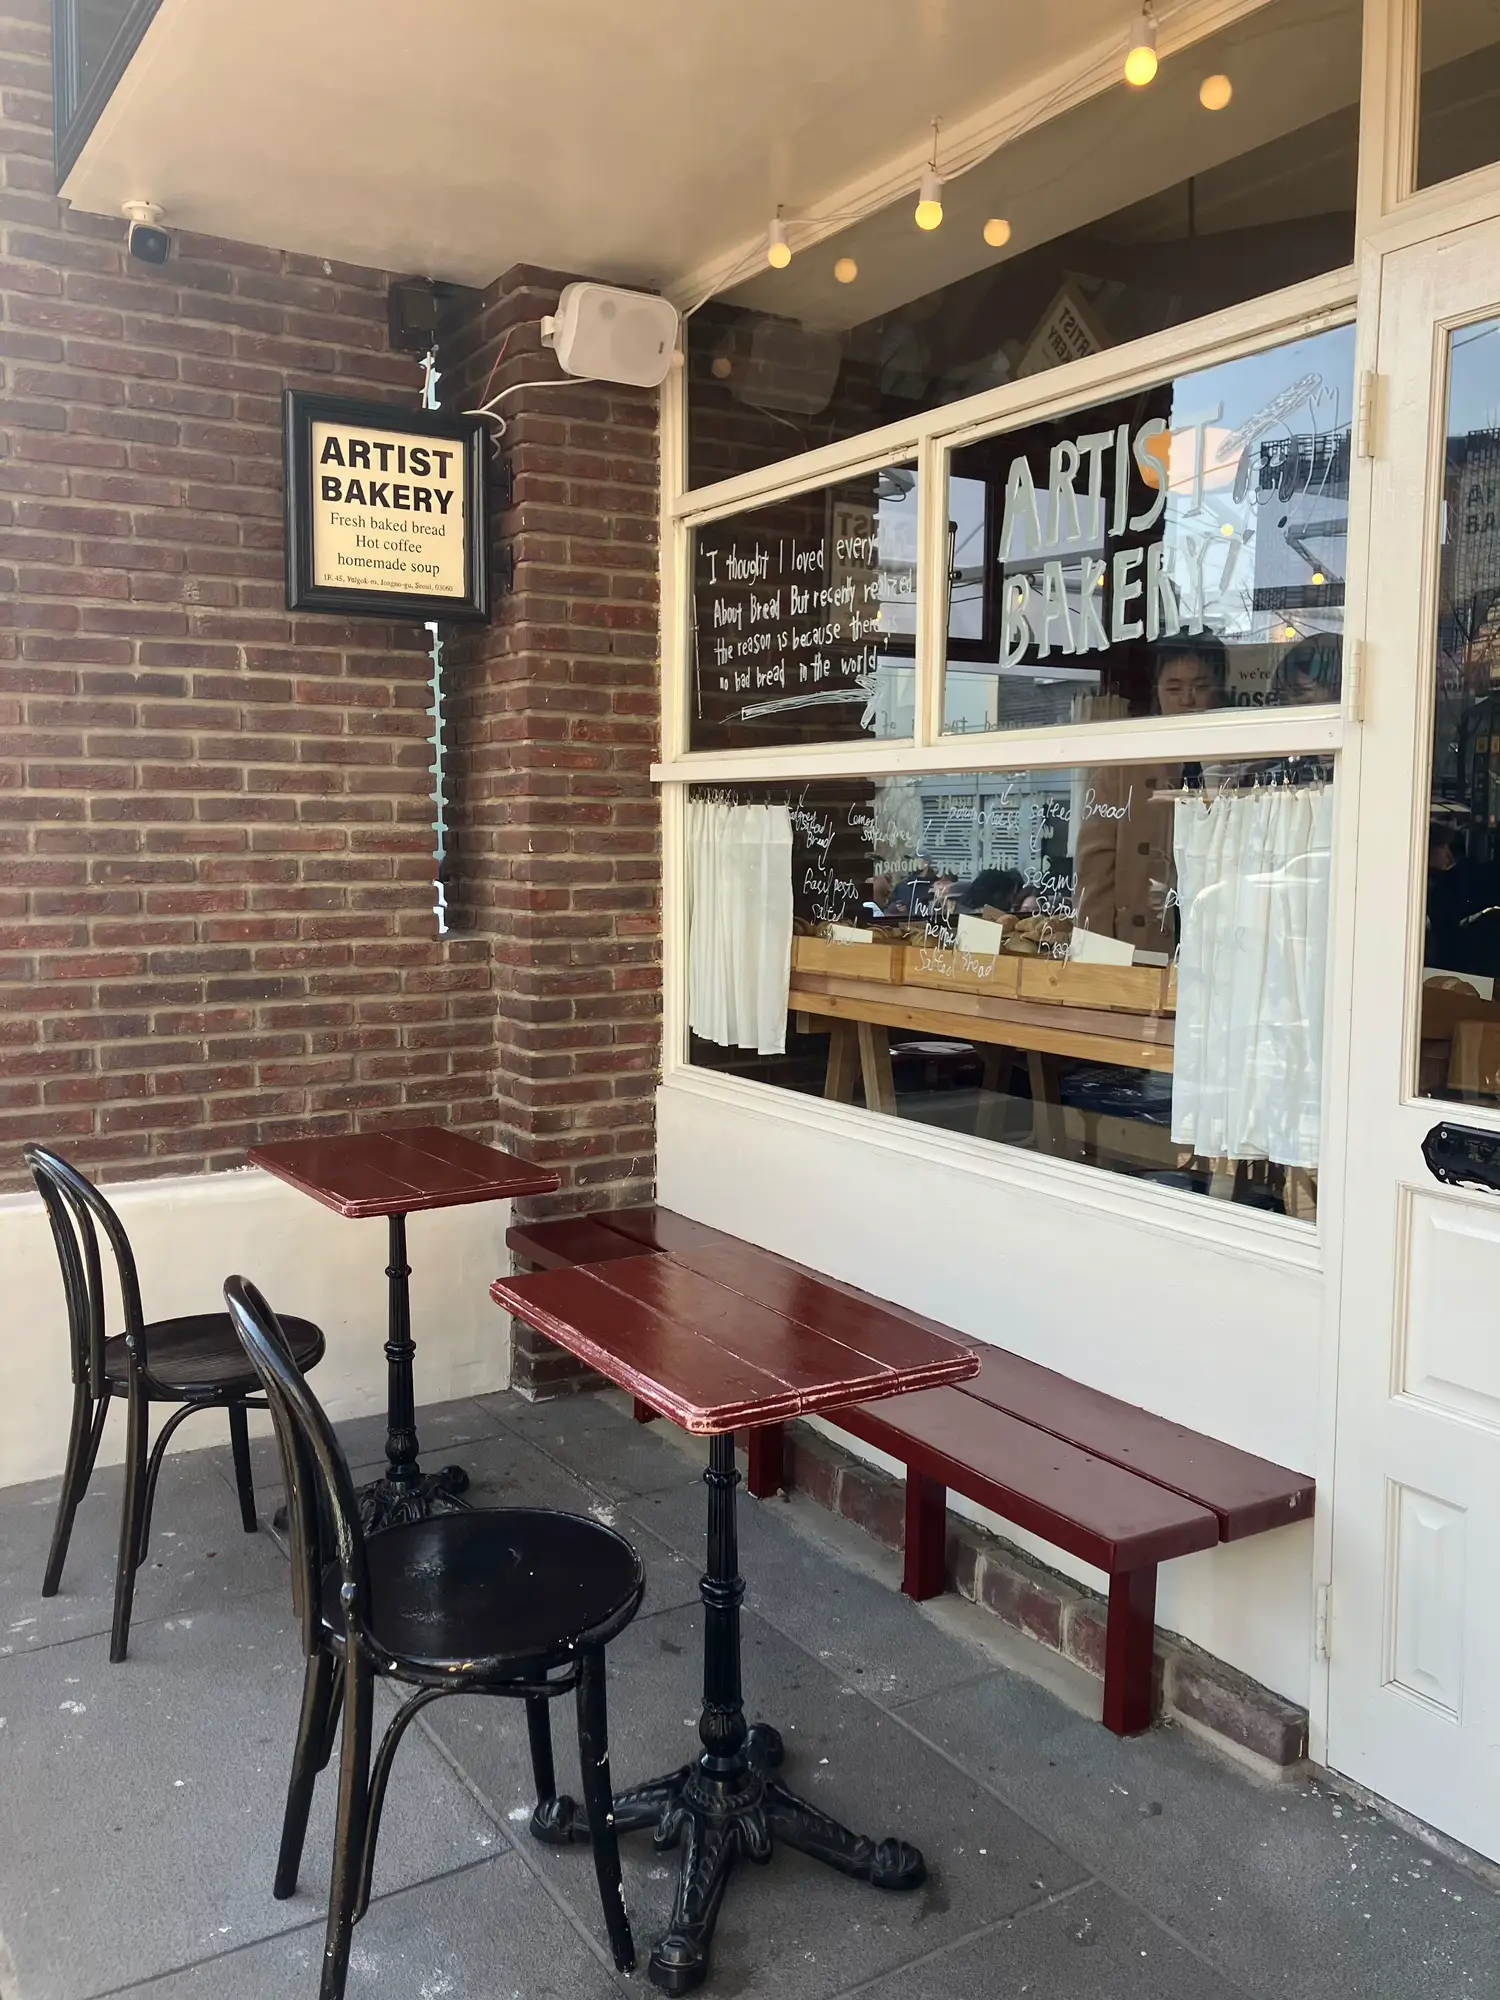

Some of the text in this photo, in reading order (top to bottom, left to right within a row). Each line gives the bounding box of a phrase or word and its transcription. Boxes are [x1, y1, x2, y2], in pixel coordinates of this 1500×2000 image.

[320, 436, 454, 479] ARTIST
[321, 475, 454, 515] BAKERY
[998, 400, 1225, 563] ARTIST
[330, 512, 446, 537] Fresh baked bread
[355, 534, 422, 553] Hot coffee
[337, 552, 440, 577] homemade soup
[726, 541, 769, 586] thought
[792, 538, 825, 574] loved
[713, 597, 743, 631] About
[749, 588, 781, 624] Bread
[790, 584, 809, 616] But
[713, 637, 733, 666] the
[737, 632, 771, 659] reason
[778, 629, 788, 652] is
[792, 622, 841, 651] because
[735, 666, 750, 693] bad
[756, 658, 785, 689] bread
[809, 651, 830, 682] the
[841, 644, 878, 677] world
[1082, 785, 1134, 823] Bread
